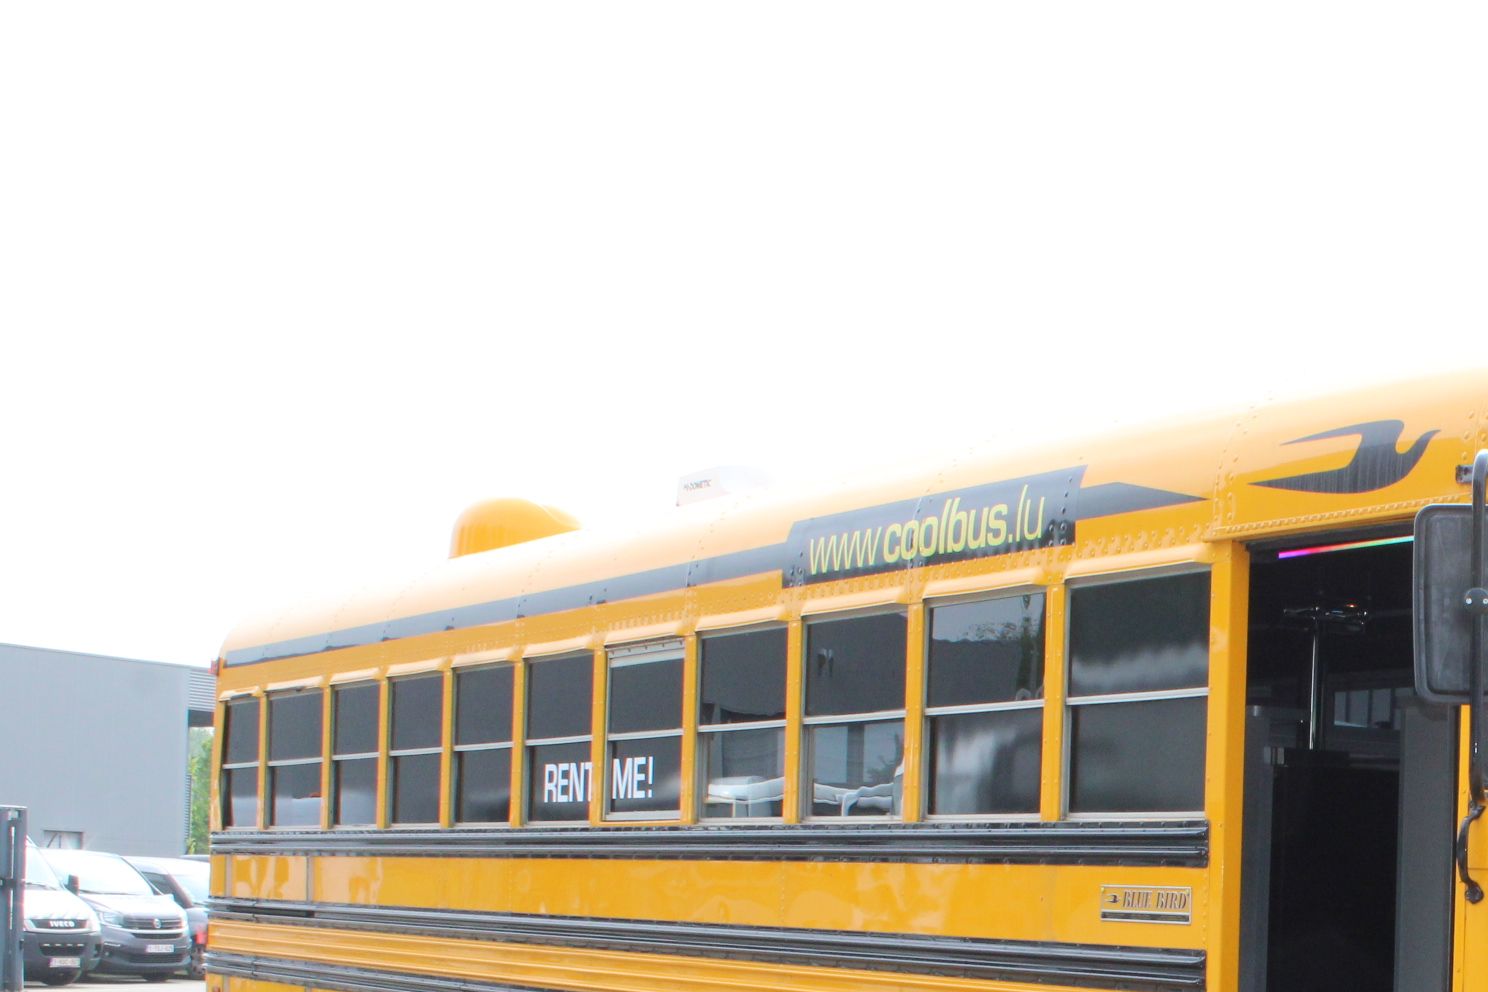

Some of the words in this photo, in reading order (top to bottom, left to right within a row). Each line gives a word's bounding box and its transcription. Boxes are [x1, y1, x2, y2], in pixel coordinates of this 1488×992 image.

[543, 762, 592, 803] RENT
[612, 756, 654, 800] ME!
[1123, 890, 1152, 908] BLUE
[1156, 892, 1187, 909] BIRD
[49, 920, 75, 928] IVECO
